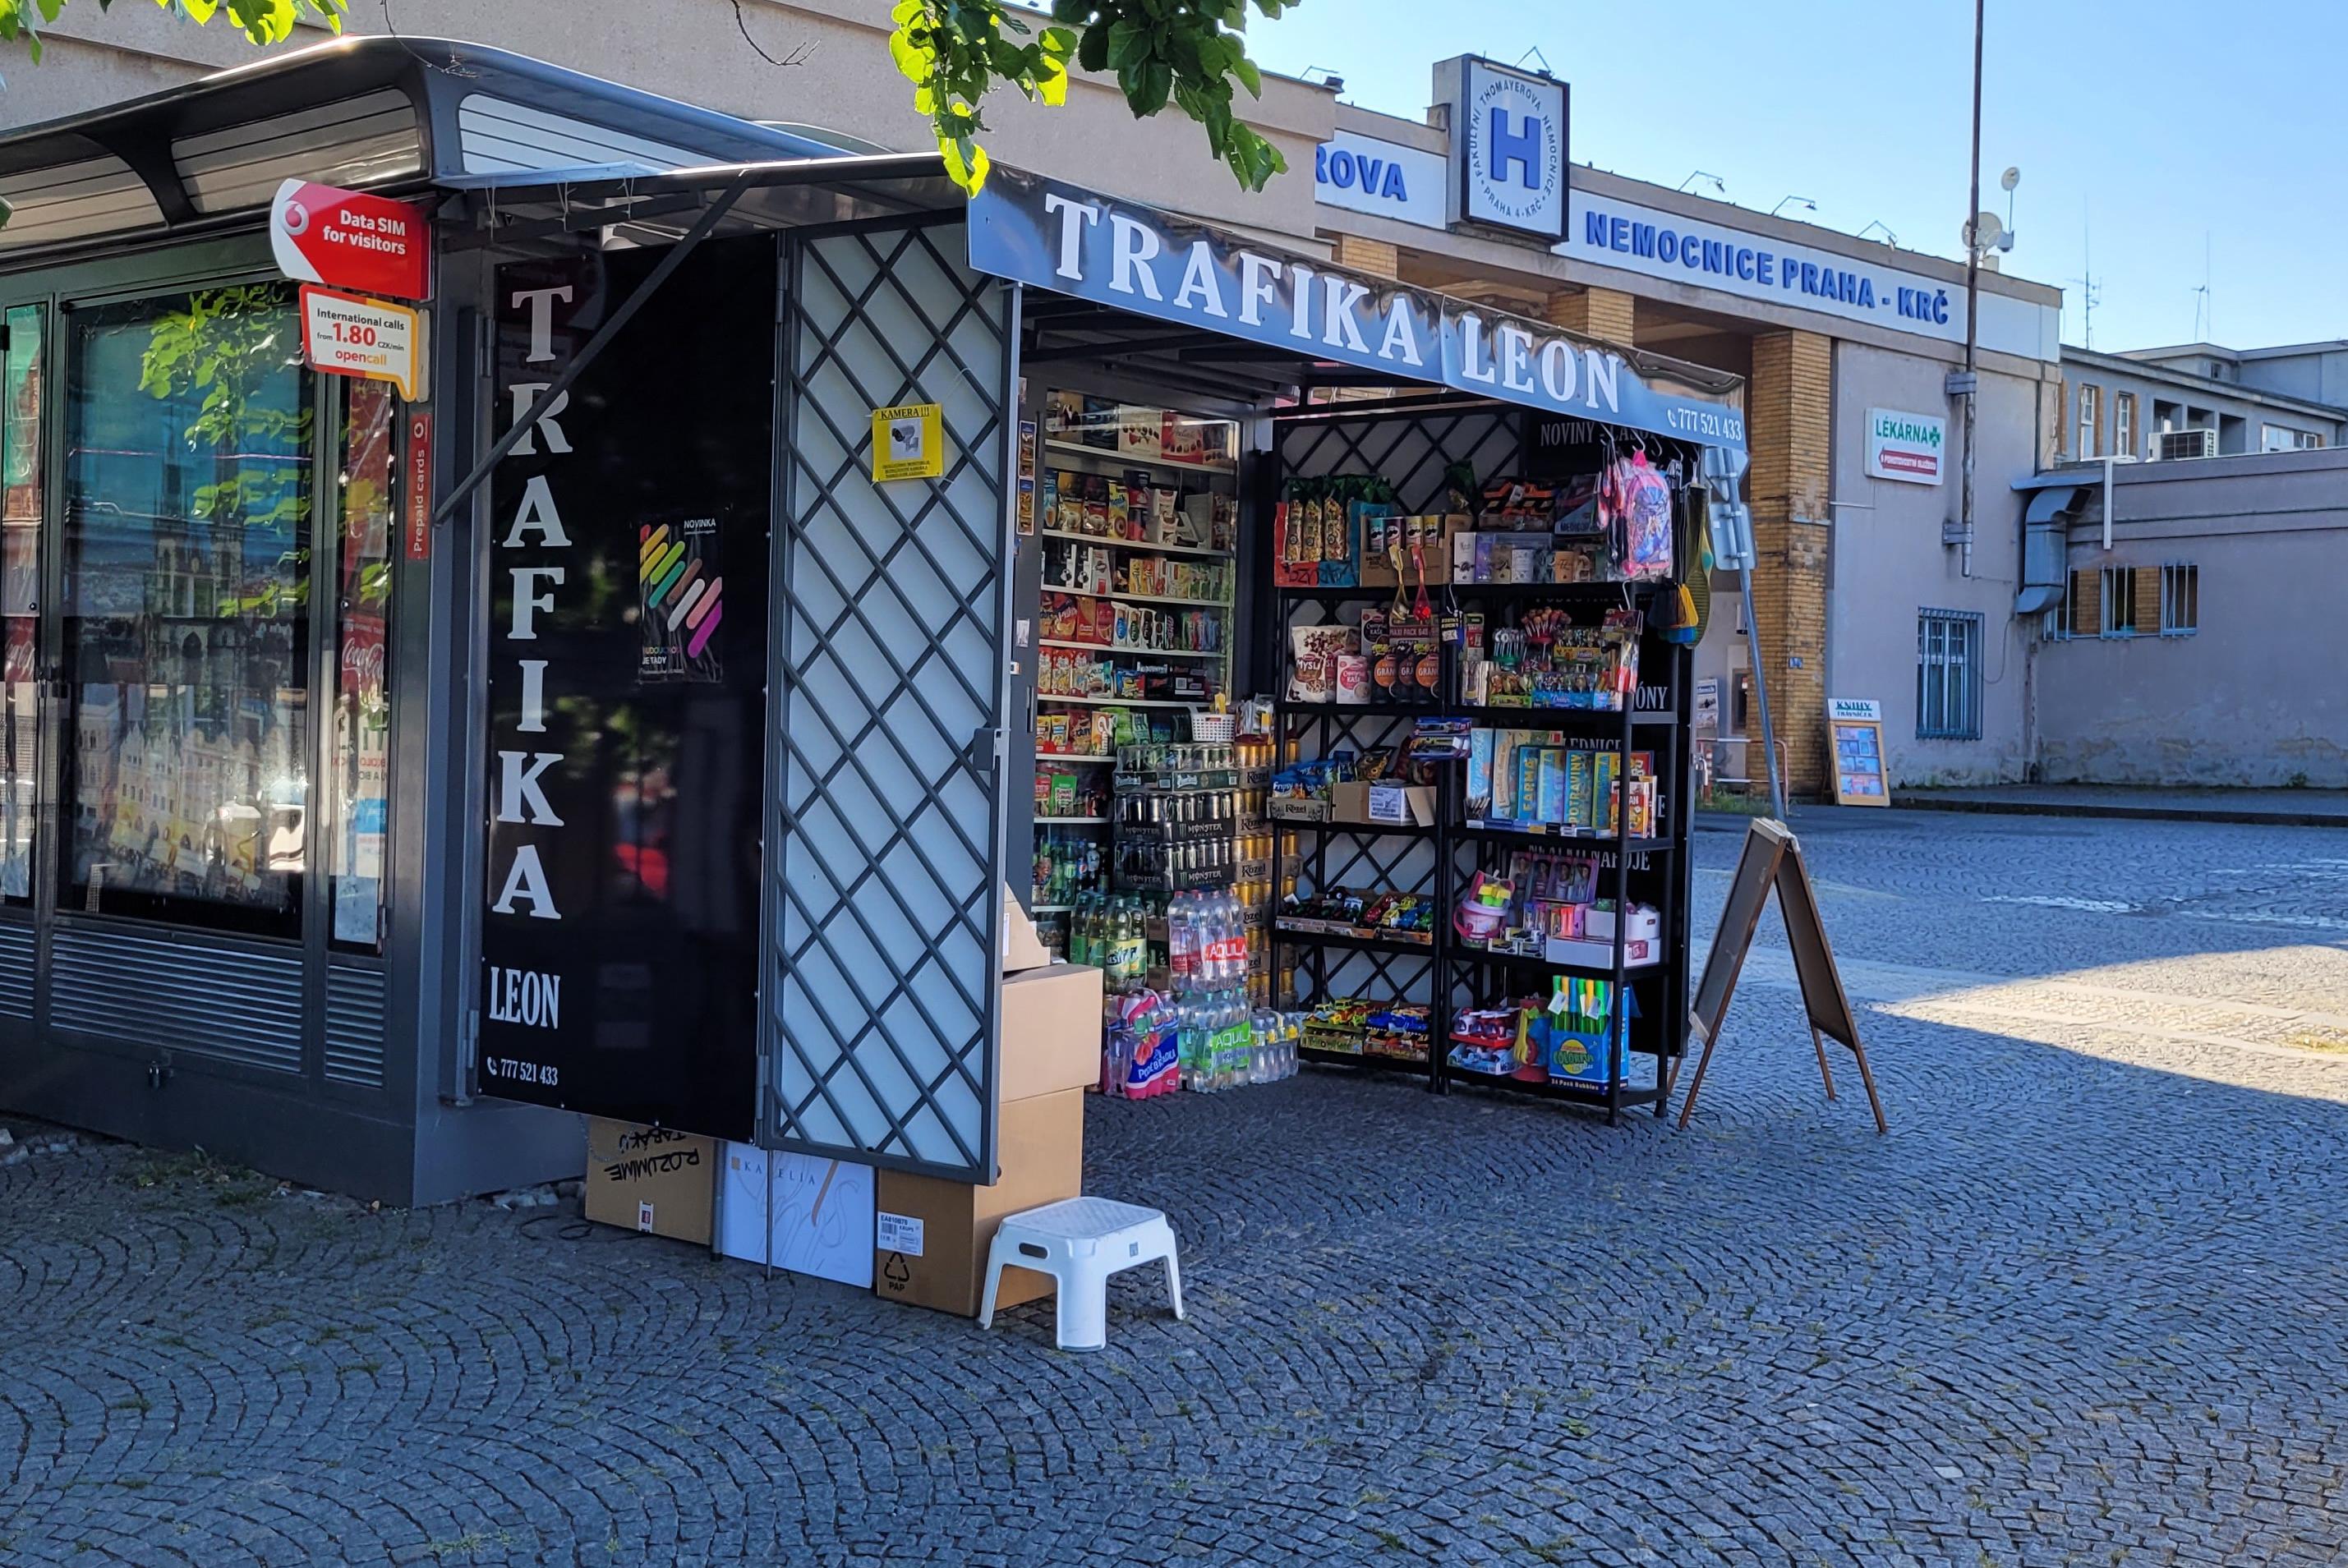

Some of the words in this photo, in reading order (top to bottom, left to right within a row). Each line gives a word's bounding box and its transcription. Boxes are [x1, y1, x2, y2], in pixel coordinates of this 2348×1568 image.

[1480, 80, 1541, 111] THOMAYEROVA
[1541, 115, 1558, 196] NEMOCNICE
[1490, 107, 1540, 190] H
[1483, 186, 1511, 217] PRAHA
[340, 209, 375, 228] Data
[378, 218, 406, 237] SIM
[323, 226, 347, 243] for
[349, 232, 406, 255] visitors
[1586, 210, 1774, 285] NEMOCNICE
[1782, 256, 1875, 309] PRAHA
[1898, 286, 1949, 324] KRČ
[1045, 193, 1424, 366] TRAFIKA
[1462, 315, 1620, 413] LEON
[317, 308, 382, 327] International
[384, 320, 404, 330] calls
[317, 332, 333, 341] from
[333, 323, 375, 347] 1.80
[378, 342, 404, 352] CZK/min
[335, 349, 387, 366] opencall
[881, 408, 918, 420] KAMERA
[1678, 407, 1698, 432] 777
[1700, 412, 1721, 437] 521
[1723, 417, 1742, 441] 433
[1540, 421, 1595, 446] NOVINY
[1876, 416, 1928, 444] LÉKÁRNA
[415, 448, 426, 492] cards
[412, 494, 427, 552] Prepaid
[684, 517, 716, 530] NOVINKA
[492, 285, 573, 920] TRAFIKA
[1188, 823, 1222, 833] MONSTER
[1188, 871, 1222, 881] MONSTER
[489, 966, 560, 1029] LEON
[500, 1058, 518, 1081] 777
[520, 1063, 537, 1083] 521
[539, 1066, 558, 1086] 433
[604, 1148, 700, 1183] ROZUMÍME
[744, 1161, 815, 1185] KAELIA
